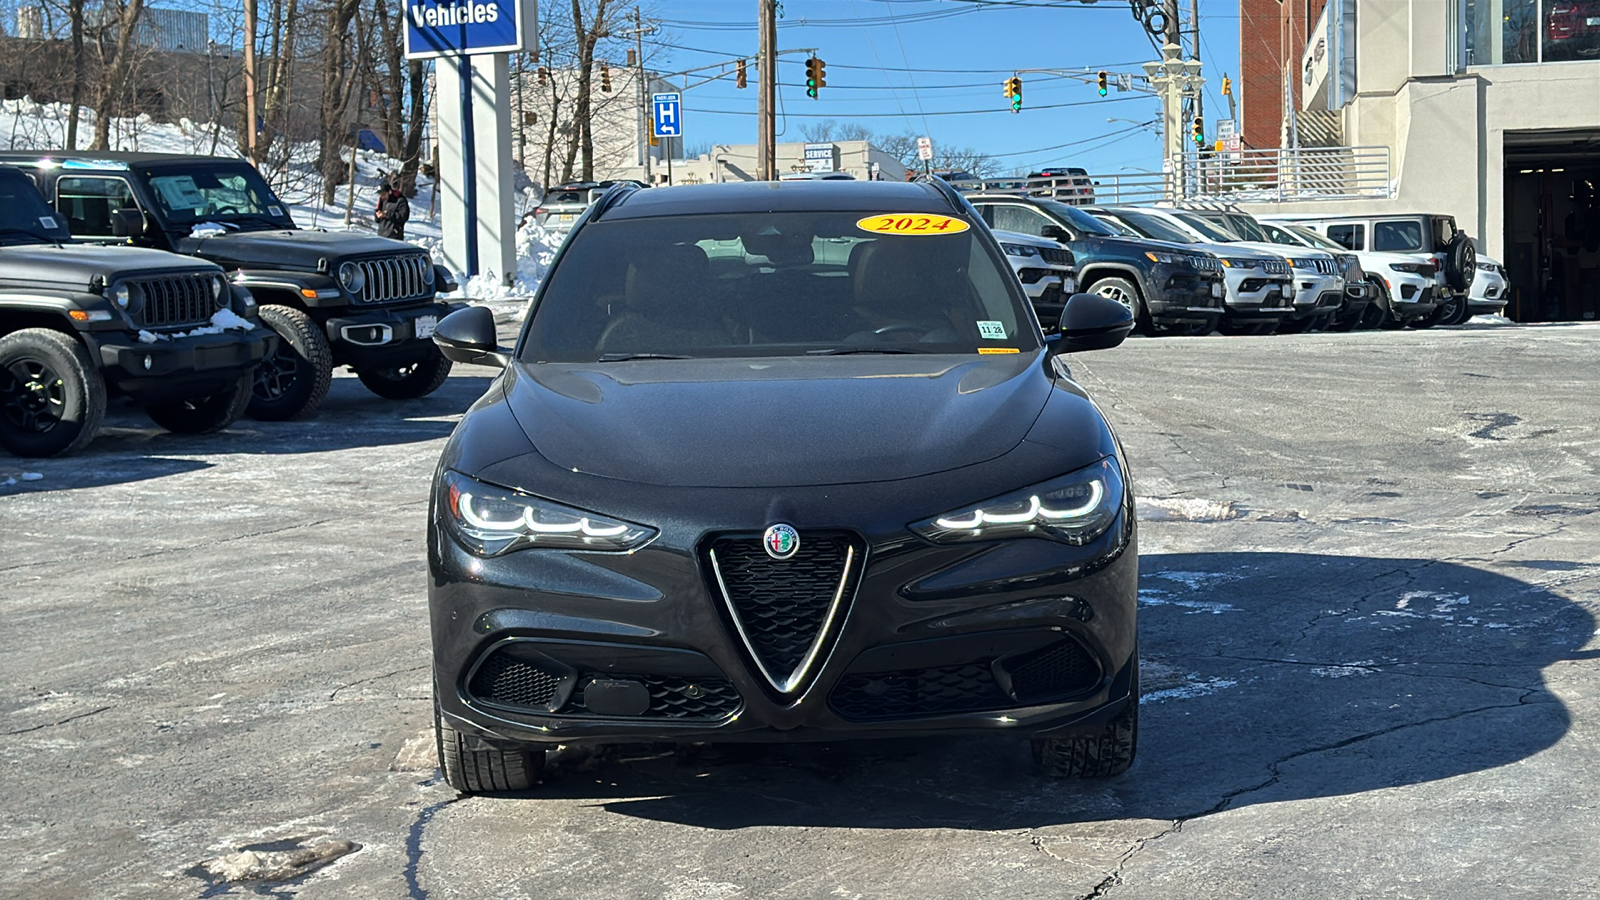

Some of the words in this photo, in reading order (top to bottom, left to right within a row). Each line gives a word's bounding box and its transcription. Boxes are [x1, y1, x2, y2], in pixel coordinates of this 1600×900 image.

[412, 0, 498, 28] Vehicles
[659, 103, 675, 124] H
[805, 150, 832, 159] SERVICE
[876, 217, 952, 231] 2024
[982, 326, 991, 334] 11
[993, 326, 1003, 334] 28
